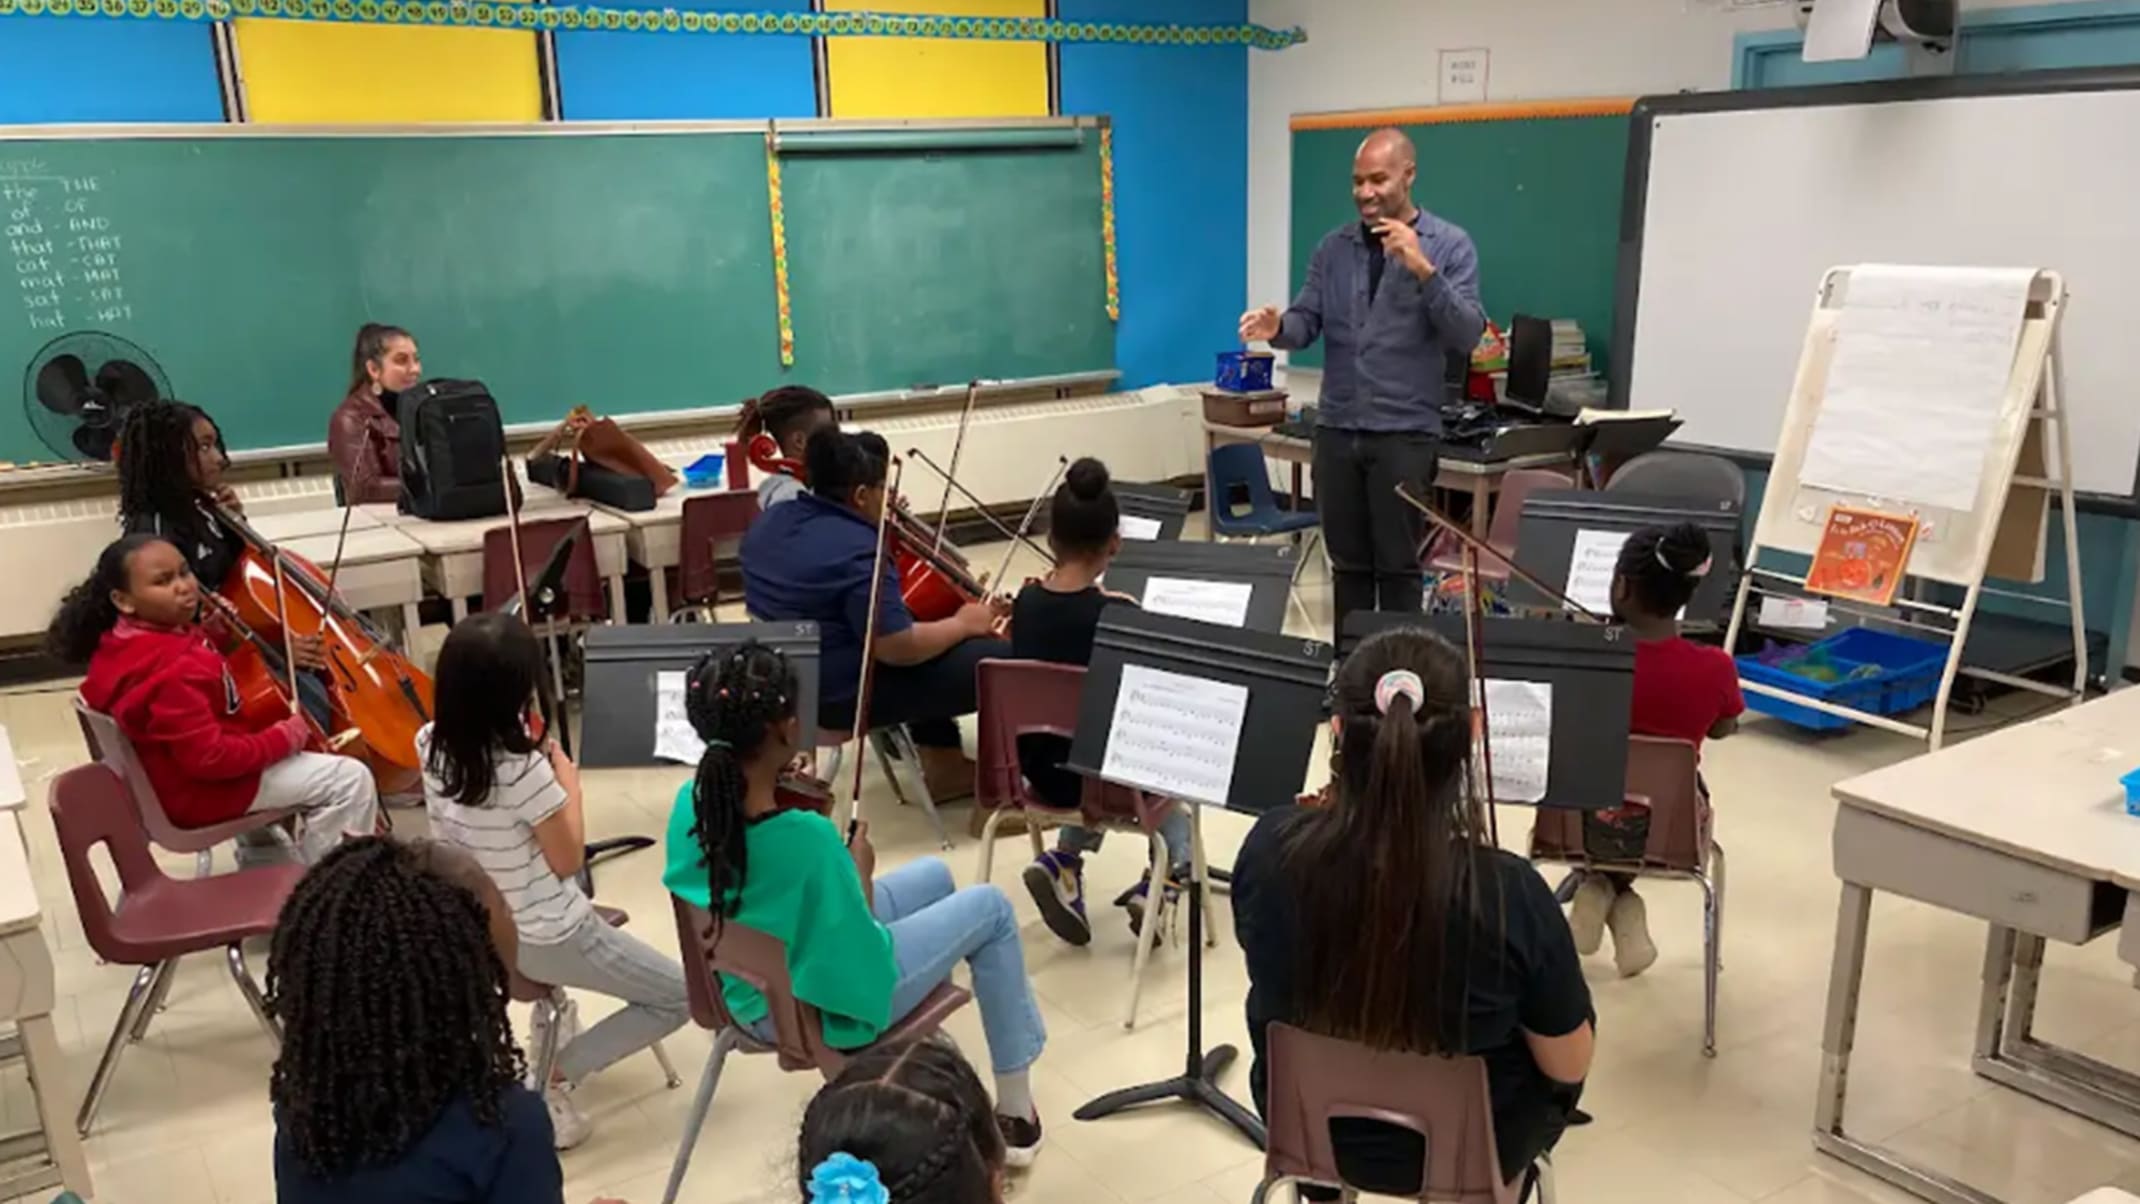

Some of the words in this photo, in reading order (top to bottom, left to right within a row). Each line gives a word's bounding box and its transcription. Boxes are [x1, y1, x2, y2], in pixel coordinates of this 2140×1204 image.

[3, 182, 38, 200] the
[63, 177, 99, 193] THE
[11, 200, 31, 221] of
[64, 197, 87, 213] OF
[5, 218, 43, 236] and
[69, 217, 110, 231] AND
[10, 239, 54, 255] that
[78, 236, 121, 251] THAT
[16, 256, 49, 273] cat
[82, 253, 117, 267] CAT
[20, 270, 64, 288] mat
[84, 268, 119, 283] MAT
[24, 289, 60, 308] sat
[90, 287, 122, 301] SAT
[29, 309, 65, 328] hat
[98, 304, 131, 321] HAT
[796, 624, 813, 636] ST
[1605, 626, 1625, 641] ST
[1303, 639, 1321, 657] ST
